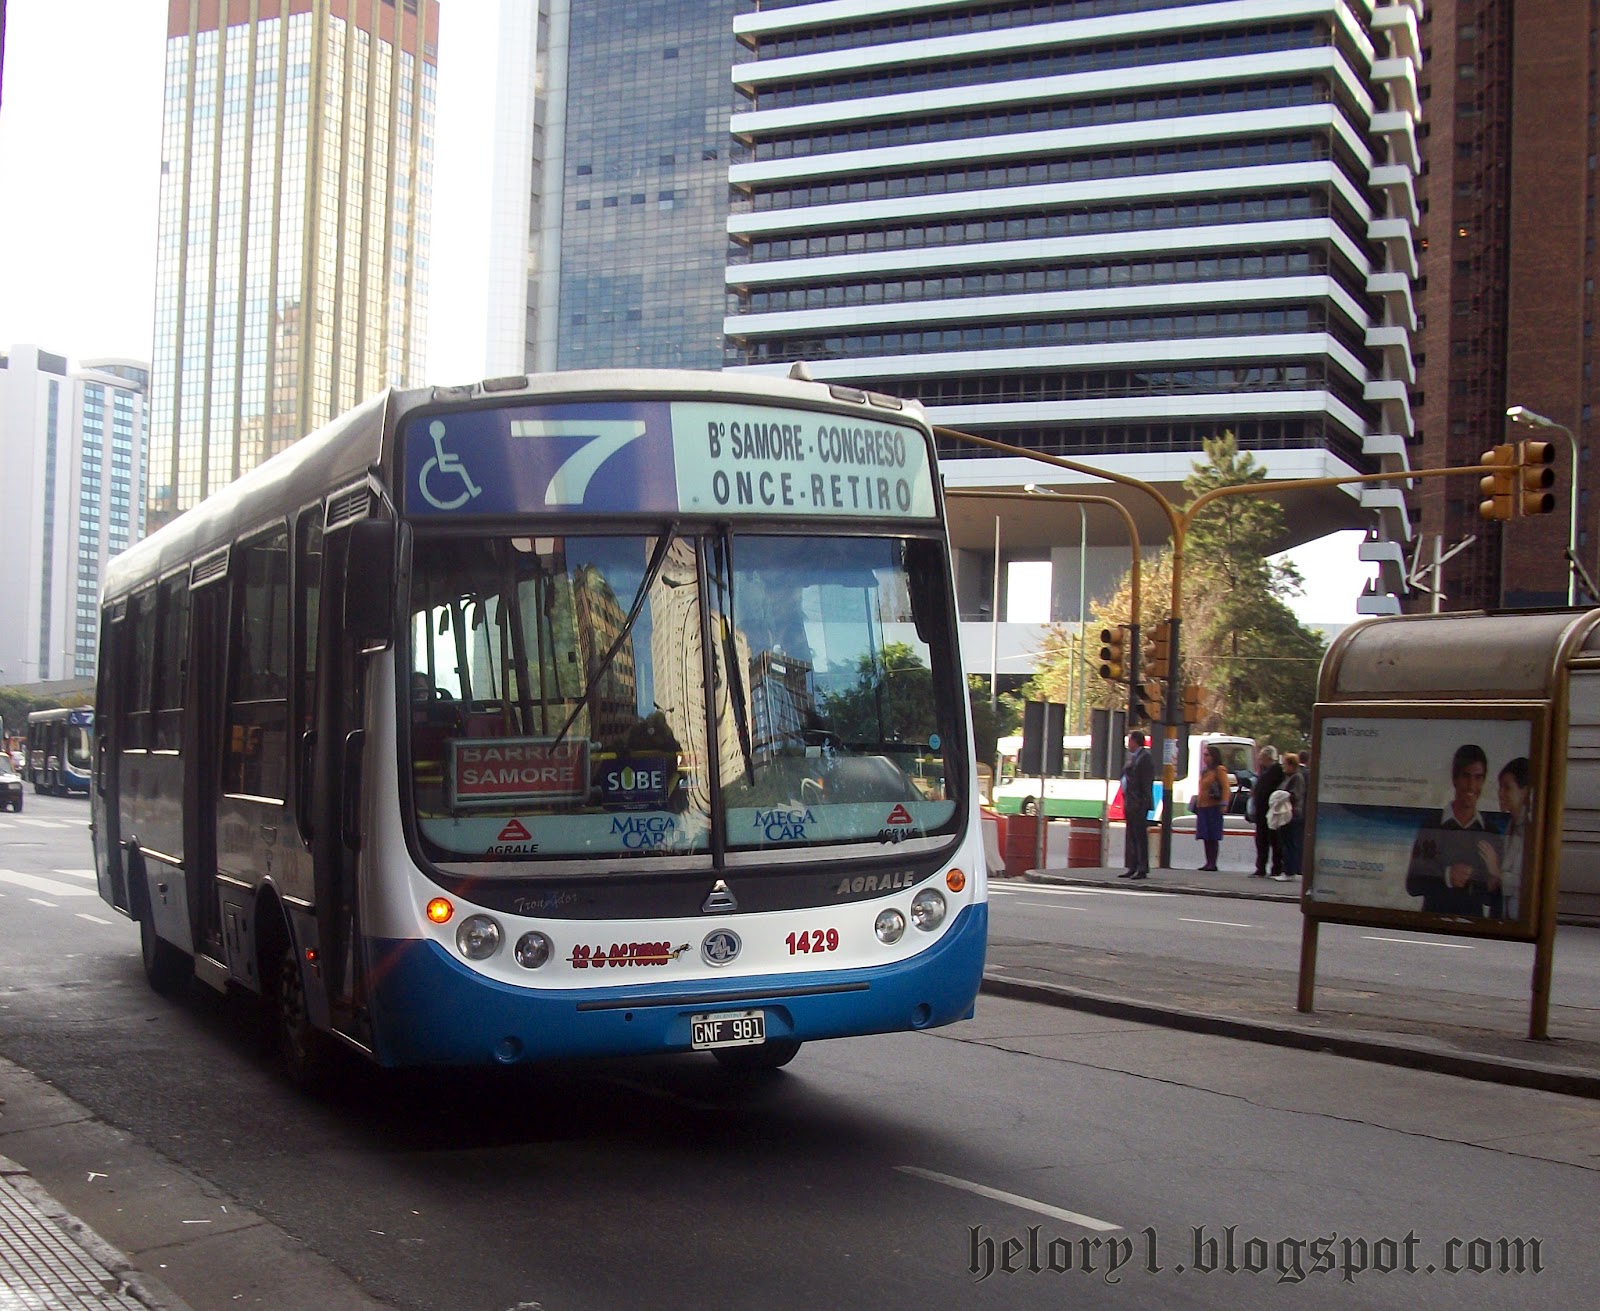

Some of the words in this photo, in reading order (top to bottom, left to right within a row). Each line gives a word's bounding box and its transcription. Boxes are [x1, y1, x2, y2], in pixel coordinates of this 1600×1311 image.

[731, 421, 805, 462] SAMORE
[817, 425, 906, 468] CONGRESO
[511, 420, 646, 504] 7
[80, 712, 95, 724] 7
[463, 747, 572, 763] BARRIO
[463, 766, 576, 785] SAMORE
[607, 767, 663, 791] SUBE
[609, 816, 675, 835] MEGA
[753, 808, 817, 828] MEGA
[622, 831, 668, 849] CAR
[764, 823, 808, 841] CAR
[486, 843, 539, 854] AGRALE
[836, 869, 916, 895] AGRALE
[785, 928, 839, 955] 1429
[694, 1022, 723, 1043] GNF
[732, 1018, 763, 1040] 981
